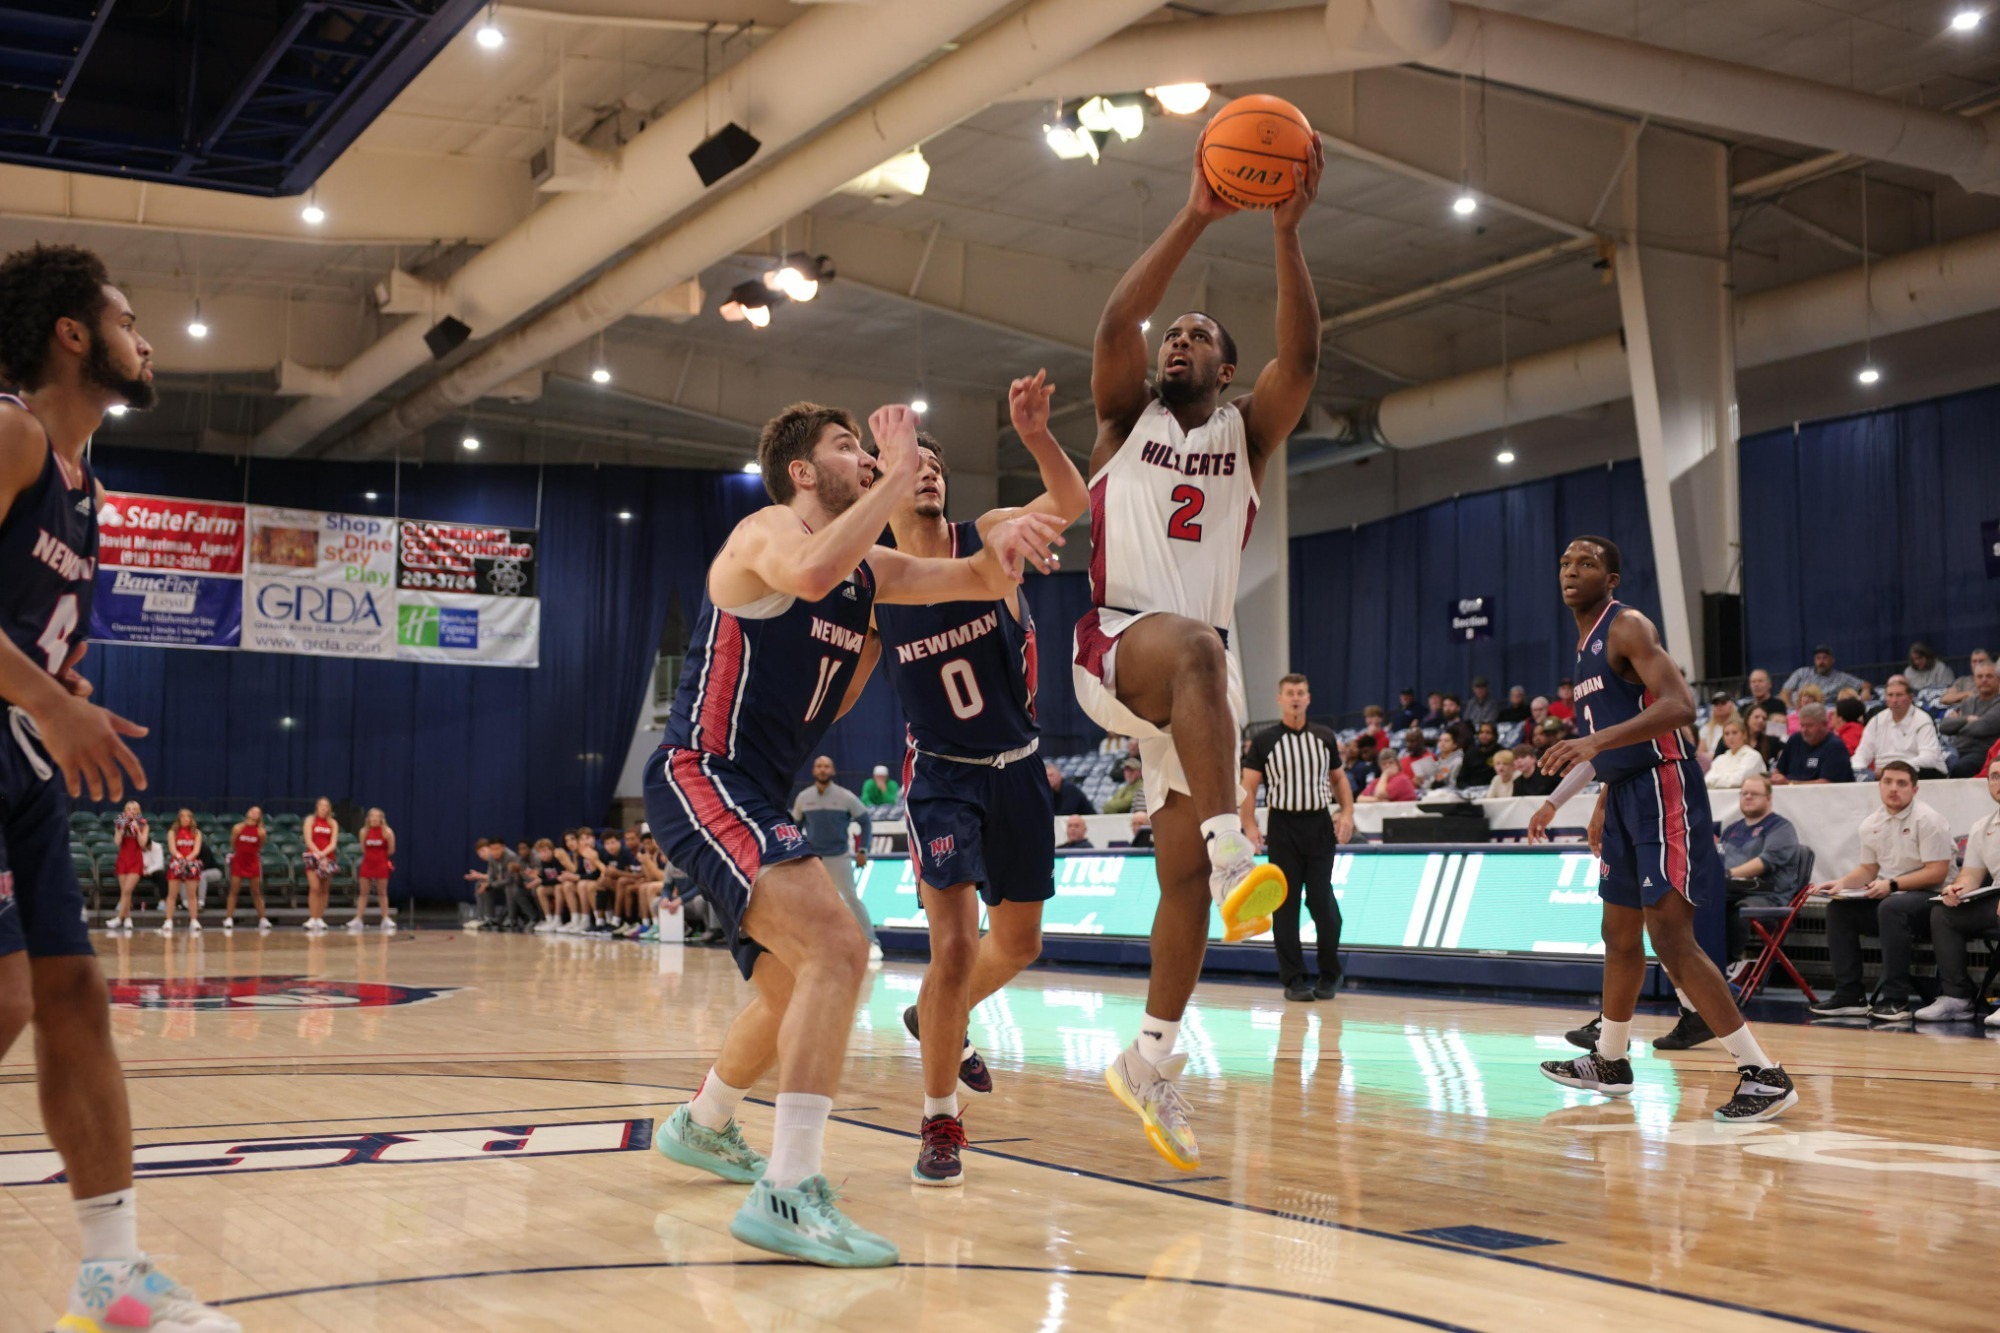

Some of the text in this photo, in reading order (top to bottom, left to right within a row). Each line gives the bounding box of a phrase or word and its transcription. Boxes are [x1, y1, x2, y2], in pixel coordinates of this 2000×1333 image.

[1236, 165, 1283, 186] EVO
[1140, 440, 1236, 477] HILLCATS
[326, 513, 381, 535] Shop
[1168, 484, 1205, 543] 2
[100, 532, 132, 549] David
[344, 534, 393, 552] Dine
[402, 538, 532, 560] COMPOUNDING
[324, 545, 371, 566] Stay
[344, 565, 390, 587] Play
[256, 583, 382, 627] GRDA
[37, 593, 79, 676] 4
[809, 616, 866, 655] NEWMA
[895, 608, 999, 664] NEWMAN
[1453, 616, 1489, 629] Section
[803, 655, 843, 722] 11
[940, 658, 985, 720] 0
[1573, 674, 1605, 702] EWMAN
